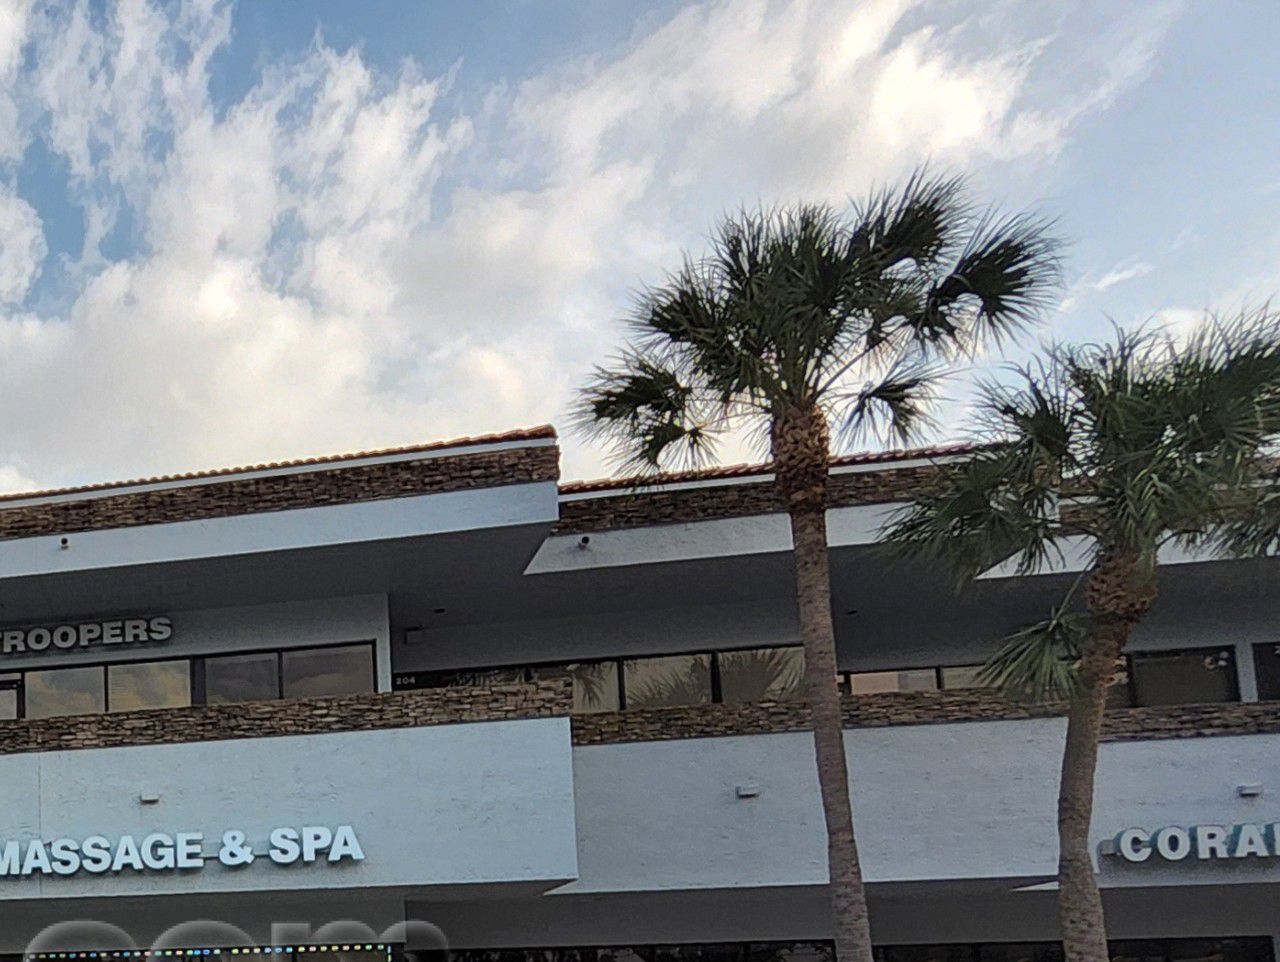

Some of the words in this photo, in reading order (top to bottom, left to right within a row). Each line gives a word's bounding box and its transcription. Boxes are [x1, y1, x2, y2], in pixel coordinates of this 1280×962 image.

[218, 829, 254, 866] &
[267, 825, 365, 864] SPA
[1120, 822, 1280, 862] CORA
